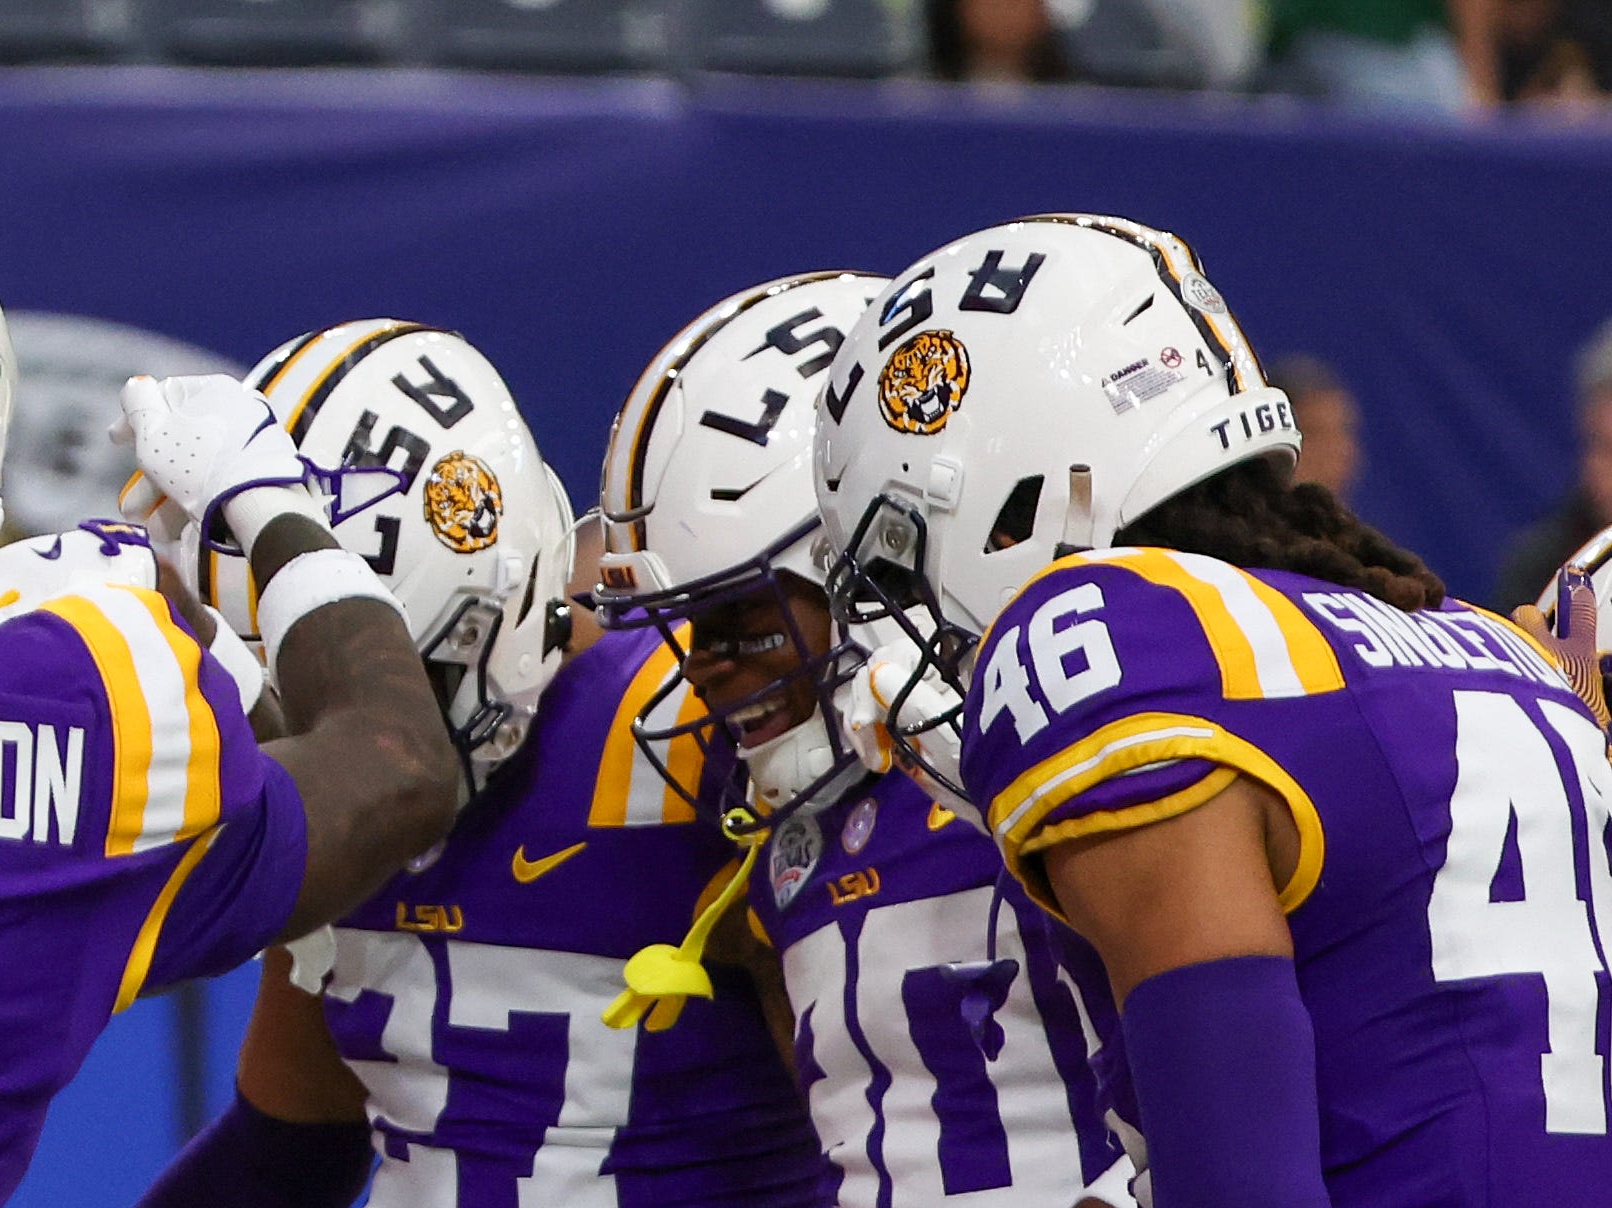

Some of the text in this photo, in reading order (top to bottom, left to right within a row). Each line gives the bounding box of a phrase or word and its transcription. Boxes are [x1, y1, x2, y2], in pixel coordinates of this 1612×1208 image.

[825, 250, 1047, 426] LSU
[1110, 358, 1150, 382] DANGER
[1195, 348, 1214, 376] 4
[1301, 591, 1575, 693] SINGLETO
[979, 582, 1124, 747] 46
[827, 867, 880, 906] LSU
[395, 900, 463, 933] LSU
